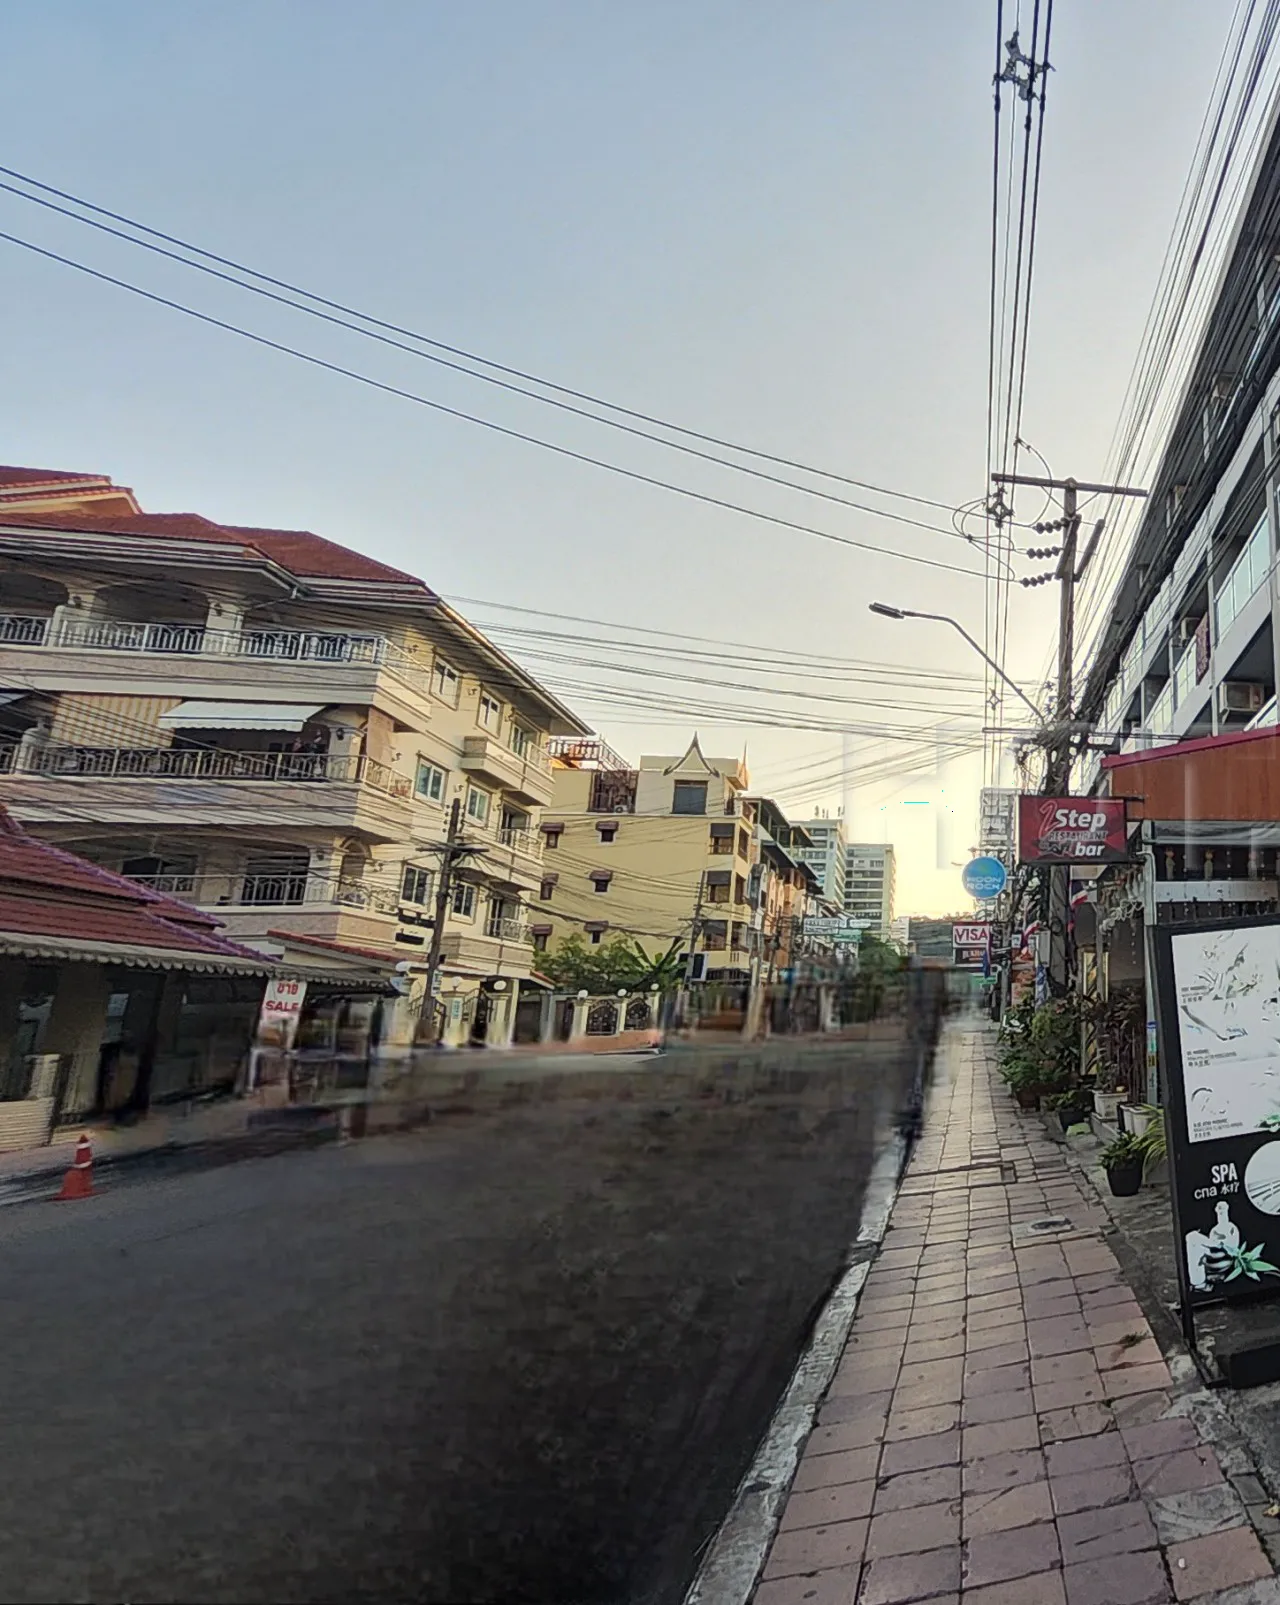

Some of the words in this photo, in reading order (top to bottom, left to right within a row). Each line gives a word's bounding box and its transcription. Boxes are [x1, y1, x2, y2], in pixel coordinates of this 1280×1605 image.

[1055, 808, 1107, 832] Step
[1048, 830, 1109, 842] RESTAURANT
[1075, 842, 1106, 857] bar
[955, 928, 988, 942] VISA
[265, 1000, 299, 1012] SALE
[1211, 1162, 1238, 1184] SPA
